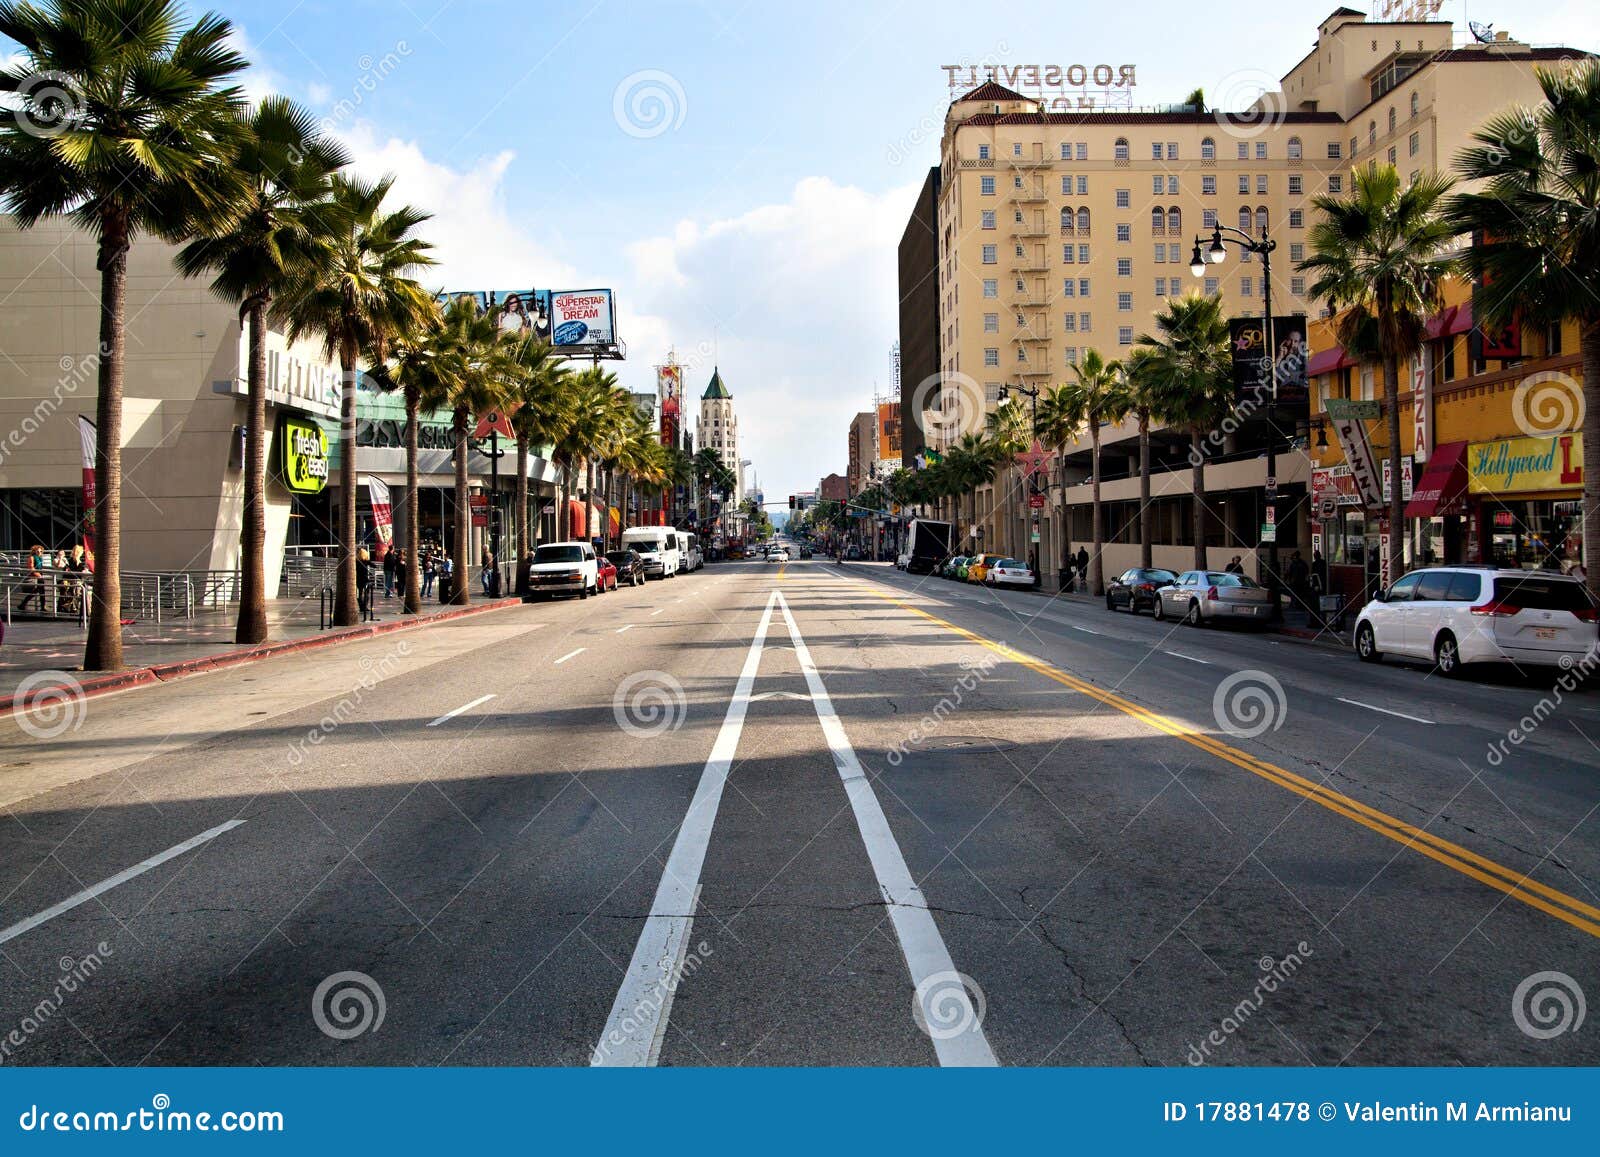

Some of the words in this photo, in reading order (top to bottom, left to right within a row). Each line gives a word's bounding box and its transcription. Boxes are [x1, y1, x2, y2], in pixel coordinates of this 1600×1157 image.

[556, 295, 605, 308] SUPERSTAR
[563, 309, 599, 320] DREAM
[1415, 352, 1425, 451] IZZA
[296, 430, 320, 457] fresh
[1472, 437, 1558, 489] Hollywood
[1341, 426, 1378, 506] PIZZA
